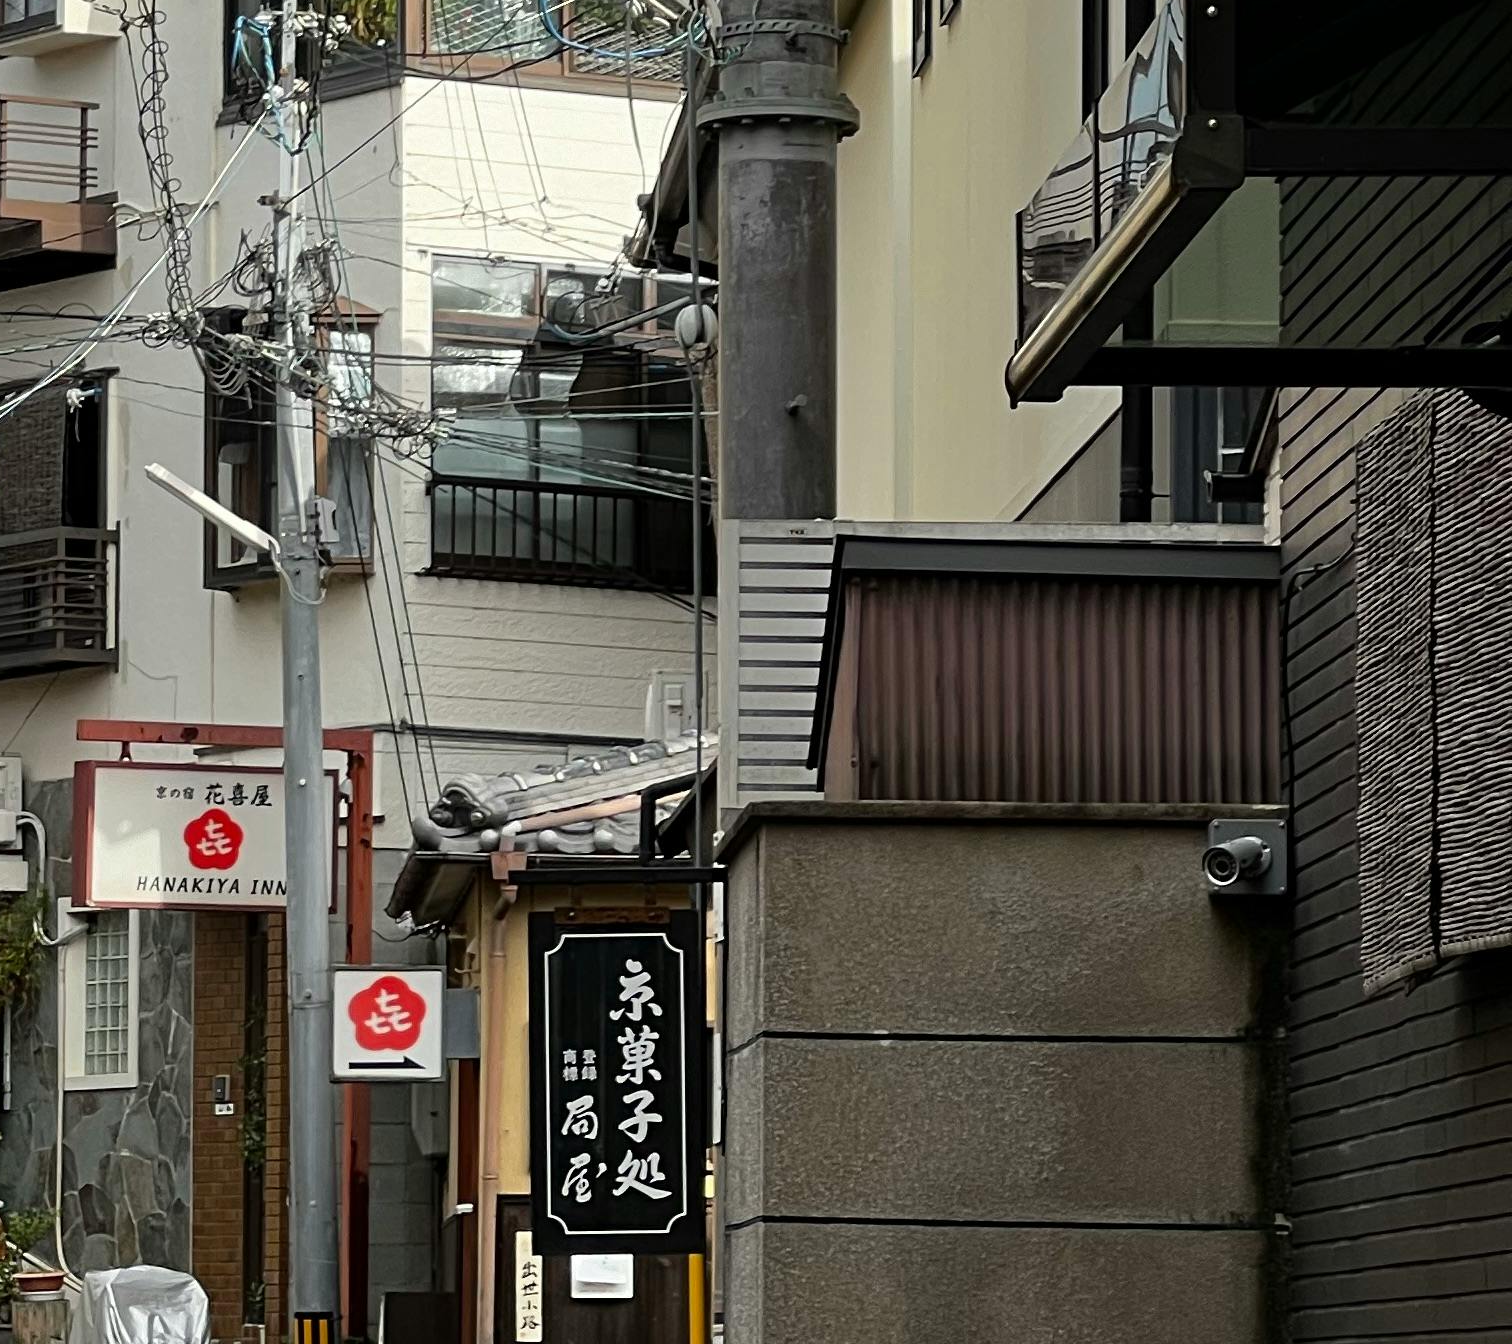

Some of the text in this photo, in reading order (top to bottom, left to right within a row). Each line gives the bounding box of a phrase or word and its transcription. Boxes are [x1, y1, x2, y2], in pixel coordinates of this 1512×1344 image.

[204, 782, 273, 807] 花喜屋
[136, 876, 287, 896] HANAKIYA INN
[608, 957, 673, 1202] 京菓子処
